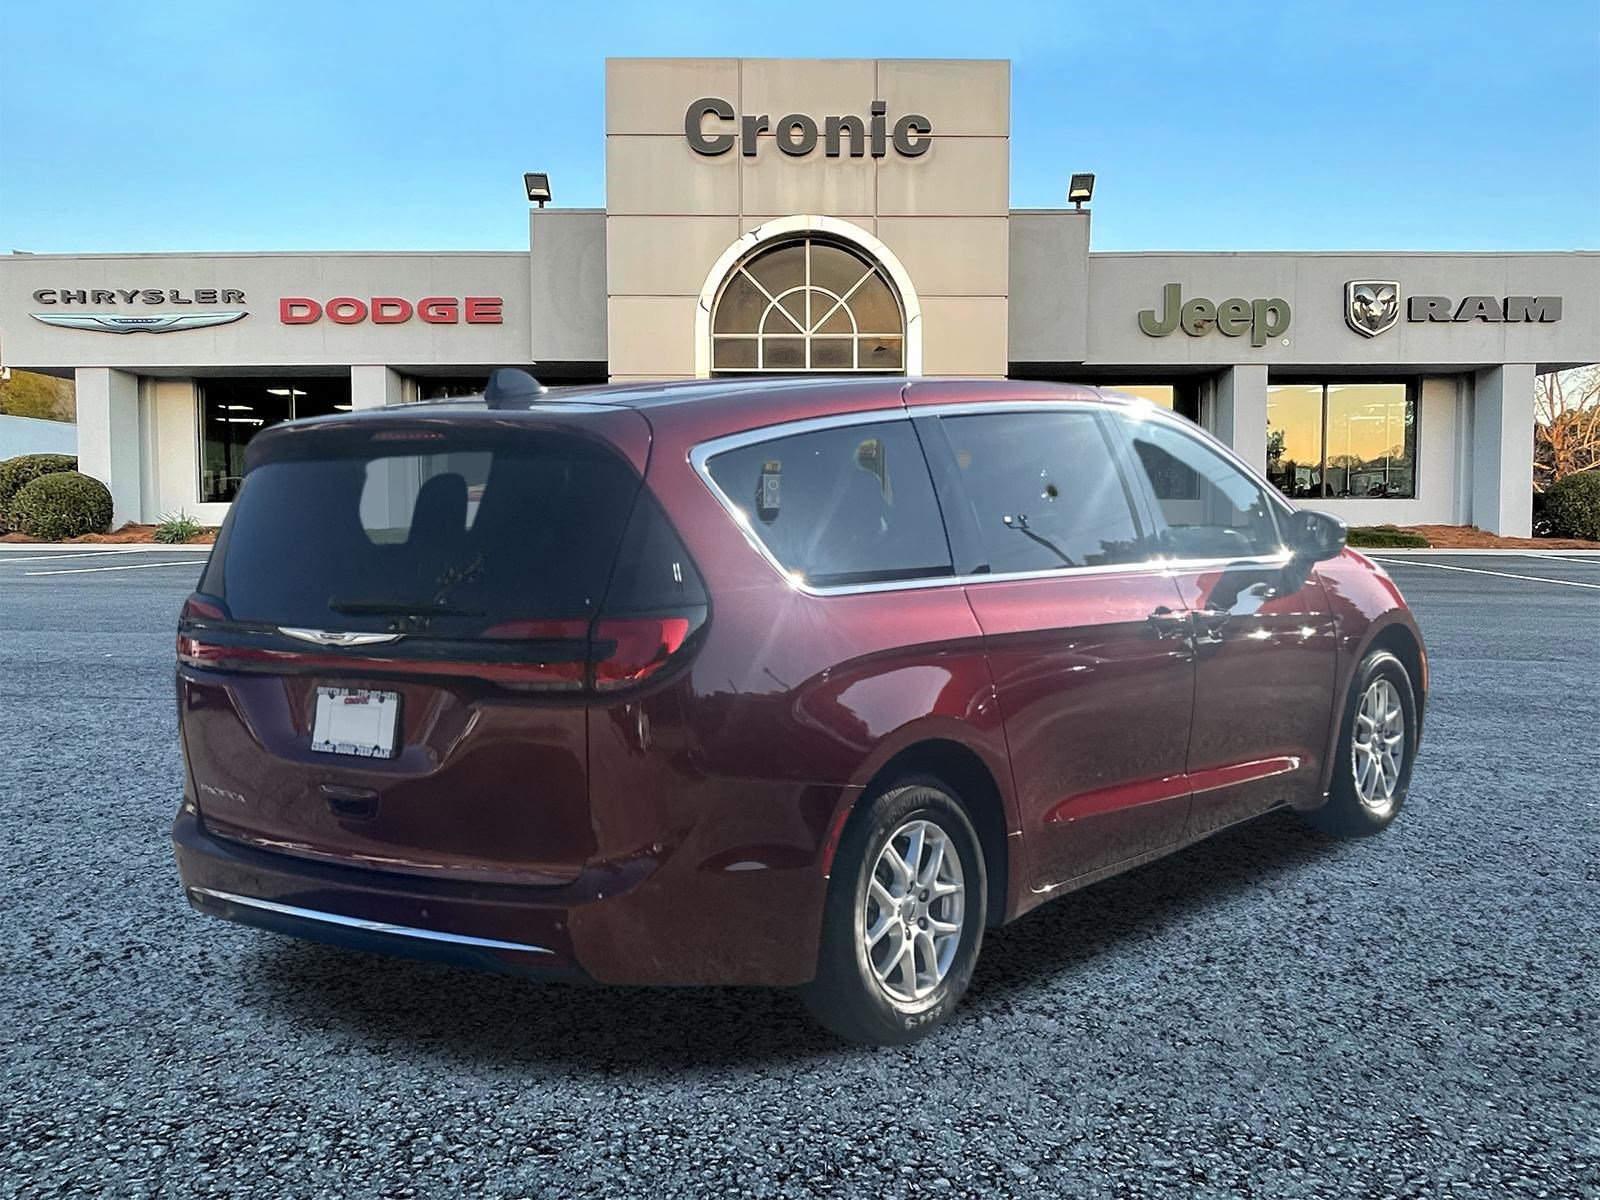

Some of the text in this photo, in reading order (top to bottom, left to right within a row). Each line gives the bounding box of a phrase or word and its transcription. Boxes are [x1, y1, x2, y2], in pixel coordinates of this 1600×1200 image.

[685, 97, 932, 157] Cronic
[32, 289, 246, 304] CHRYSLER
[1407, 296, 1562, 322] RAM
[280, 297, 503, 324] DODGE
[1138, 283, 1291, 347] Jeep
